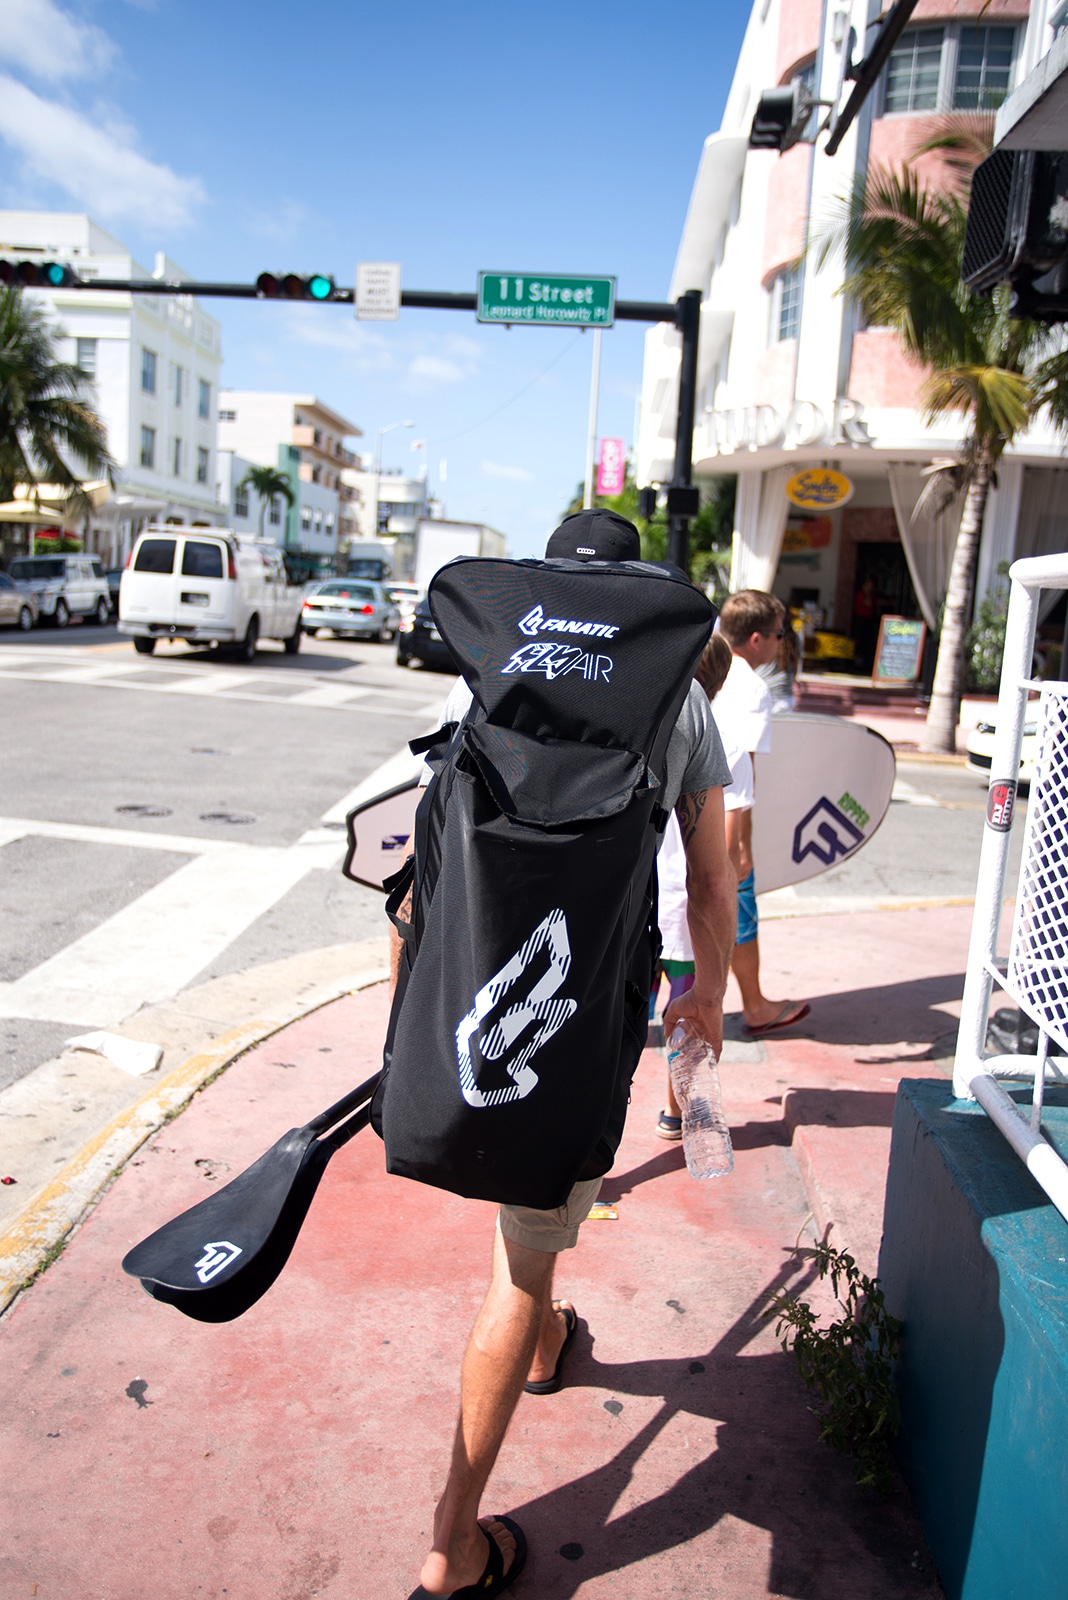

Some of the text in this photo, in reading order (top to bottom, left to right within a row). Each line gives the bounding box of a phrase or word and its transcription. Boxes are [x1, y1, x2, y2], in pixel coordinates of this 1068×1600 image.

[528, 281, 594, 304] Street
[702, 397, 872, 453] TUDOR
[540, 618, 620, 639] FANATIC
[563, 653, 614, 683] AIR
